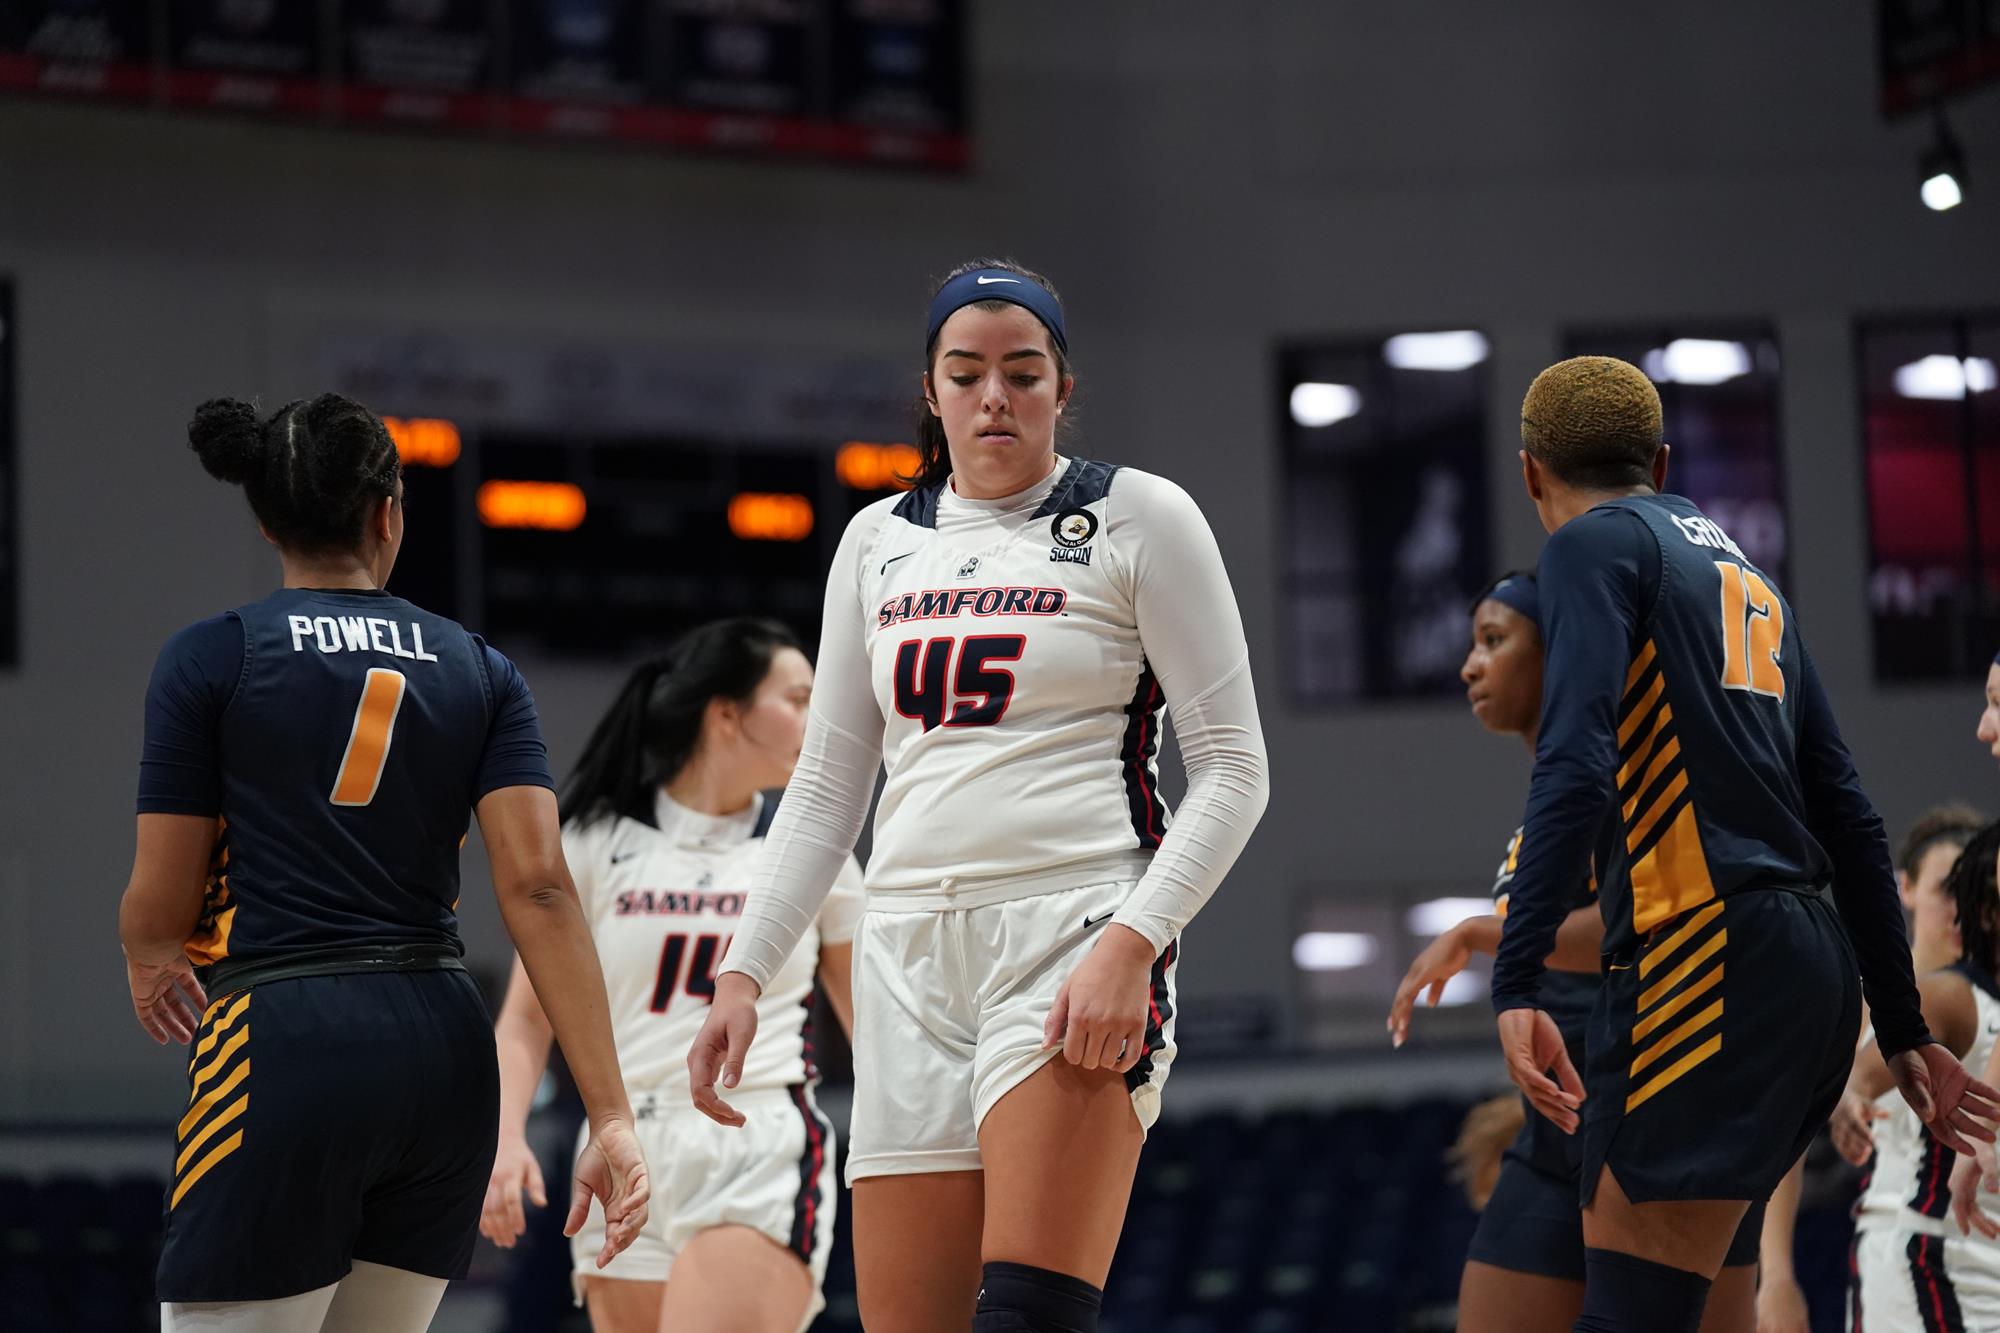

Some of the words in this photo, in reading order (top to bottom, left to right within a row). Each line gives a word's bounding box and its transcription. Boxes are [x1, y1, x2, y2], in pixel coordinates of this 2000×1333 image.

[1050, 546, 1092, 566] SOCON
[1670, 513, 1754, 567] CRU
[877, 587, 1067, 631] SAMFORD
[1714, 560, 1785, 704] 12
[288, 615, 438, 662] POWELL
[893, 633, 1027, 736] 45
[329, 667, 406, 807] 1
[615, 888, 748, 918] SAMFO
